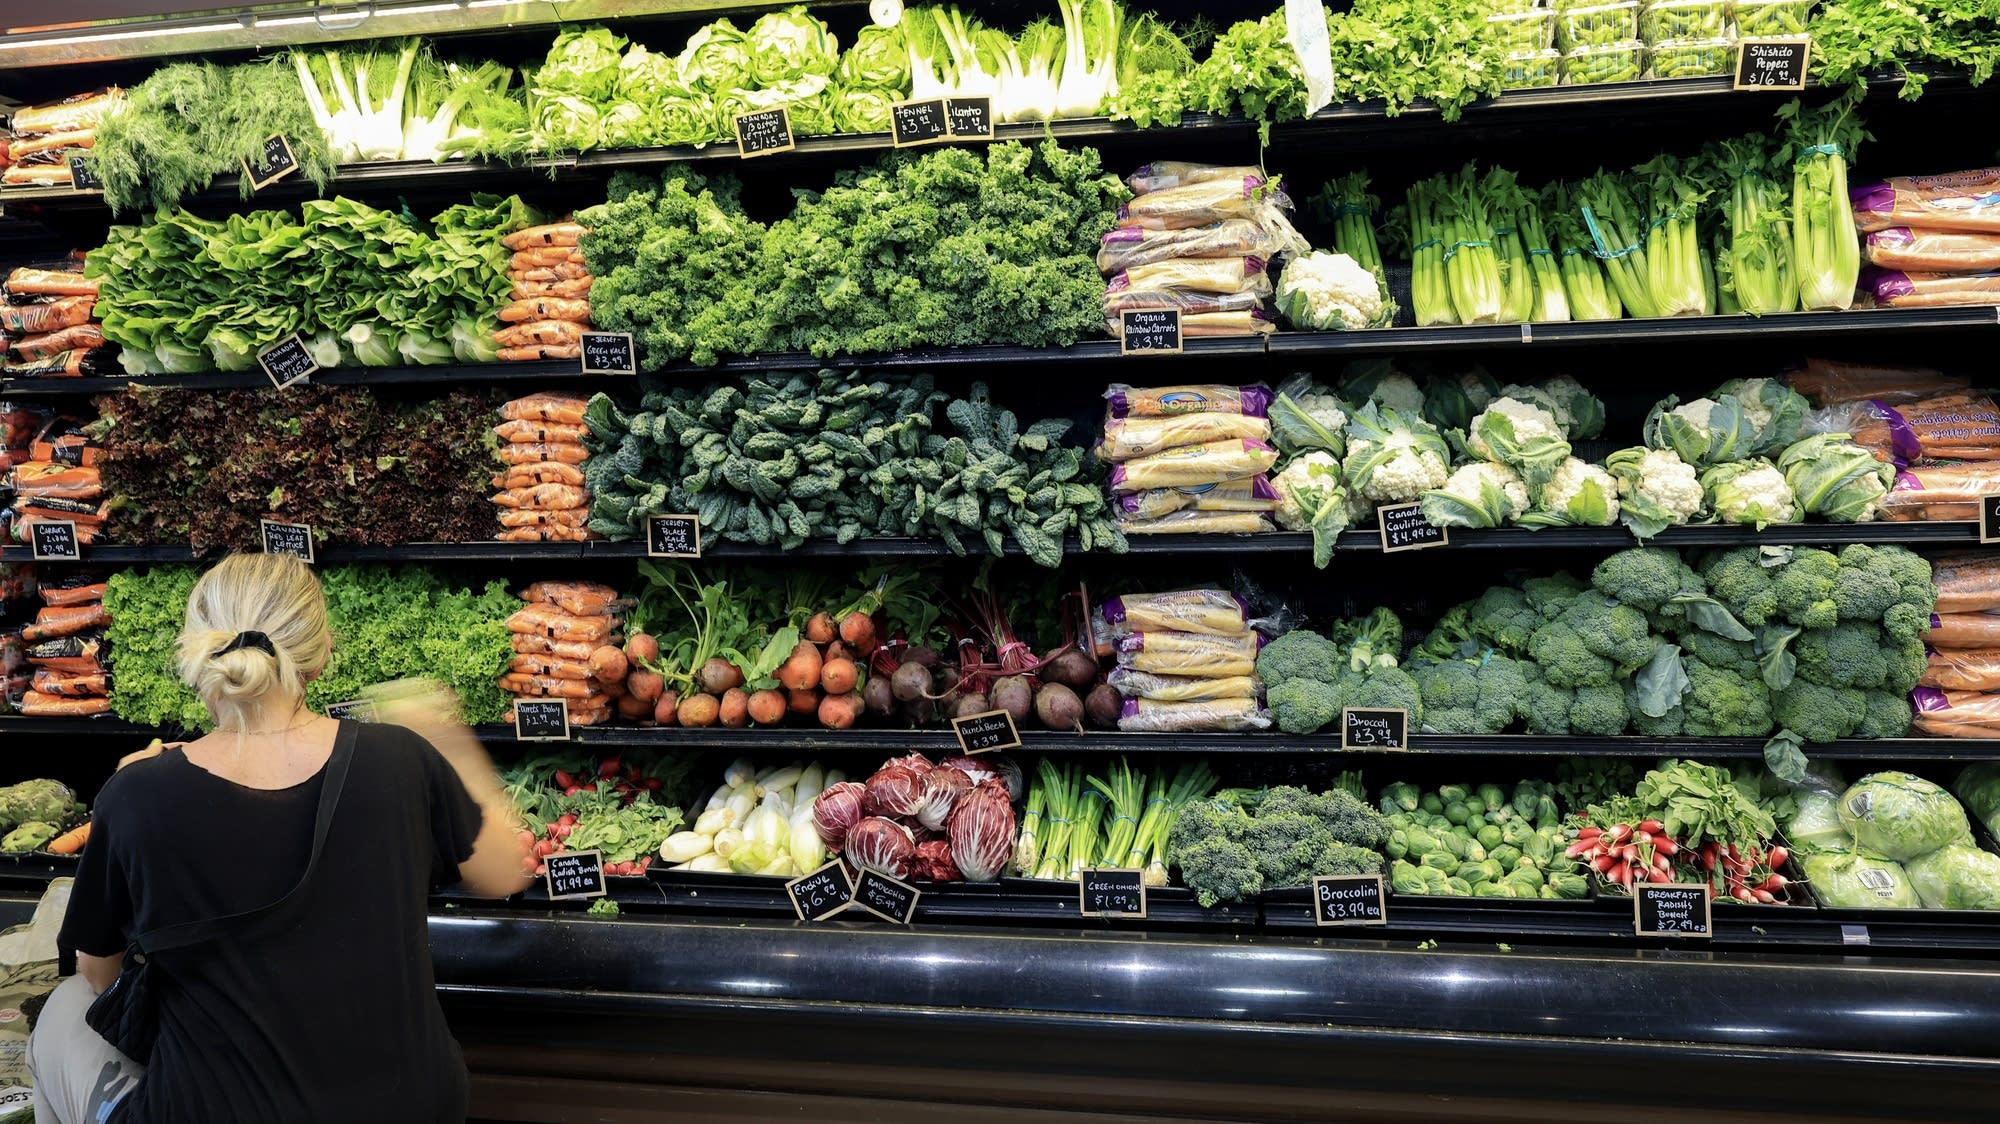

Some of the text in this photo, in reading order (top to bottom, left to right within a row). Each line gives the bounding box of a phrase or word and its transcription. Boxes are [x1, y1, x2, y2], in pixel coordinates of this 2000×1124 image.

[1756, 57, 1789, 71] Peppers
[1135, 311, 1166, 325] Organic
[1126, 322, 1176, 334] Rainbow Carrots
[1386, 518, 1427, 532] Cauliflo
[1391, 528, 1438, 545] $4.99 ea
[1347, 712, 1388, 728] Broccoli
[552, 857, 580, 868] Canada
[551, 867, 576, 879] Radish
[556, 876, 582, 892] $1.99
[794, 875, 830, 896] Endive
[1318, 883, 1378, 901] Broccolini
[1647, 890, 1700, 900] BREAKFAST
[1327, 902, 1380, 919] $3.99 ea
